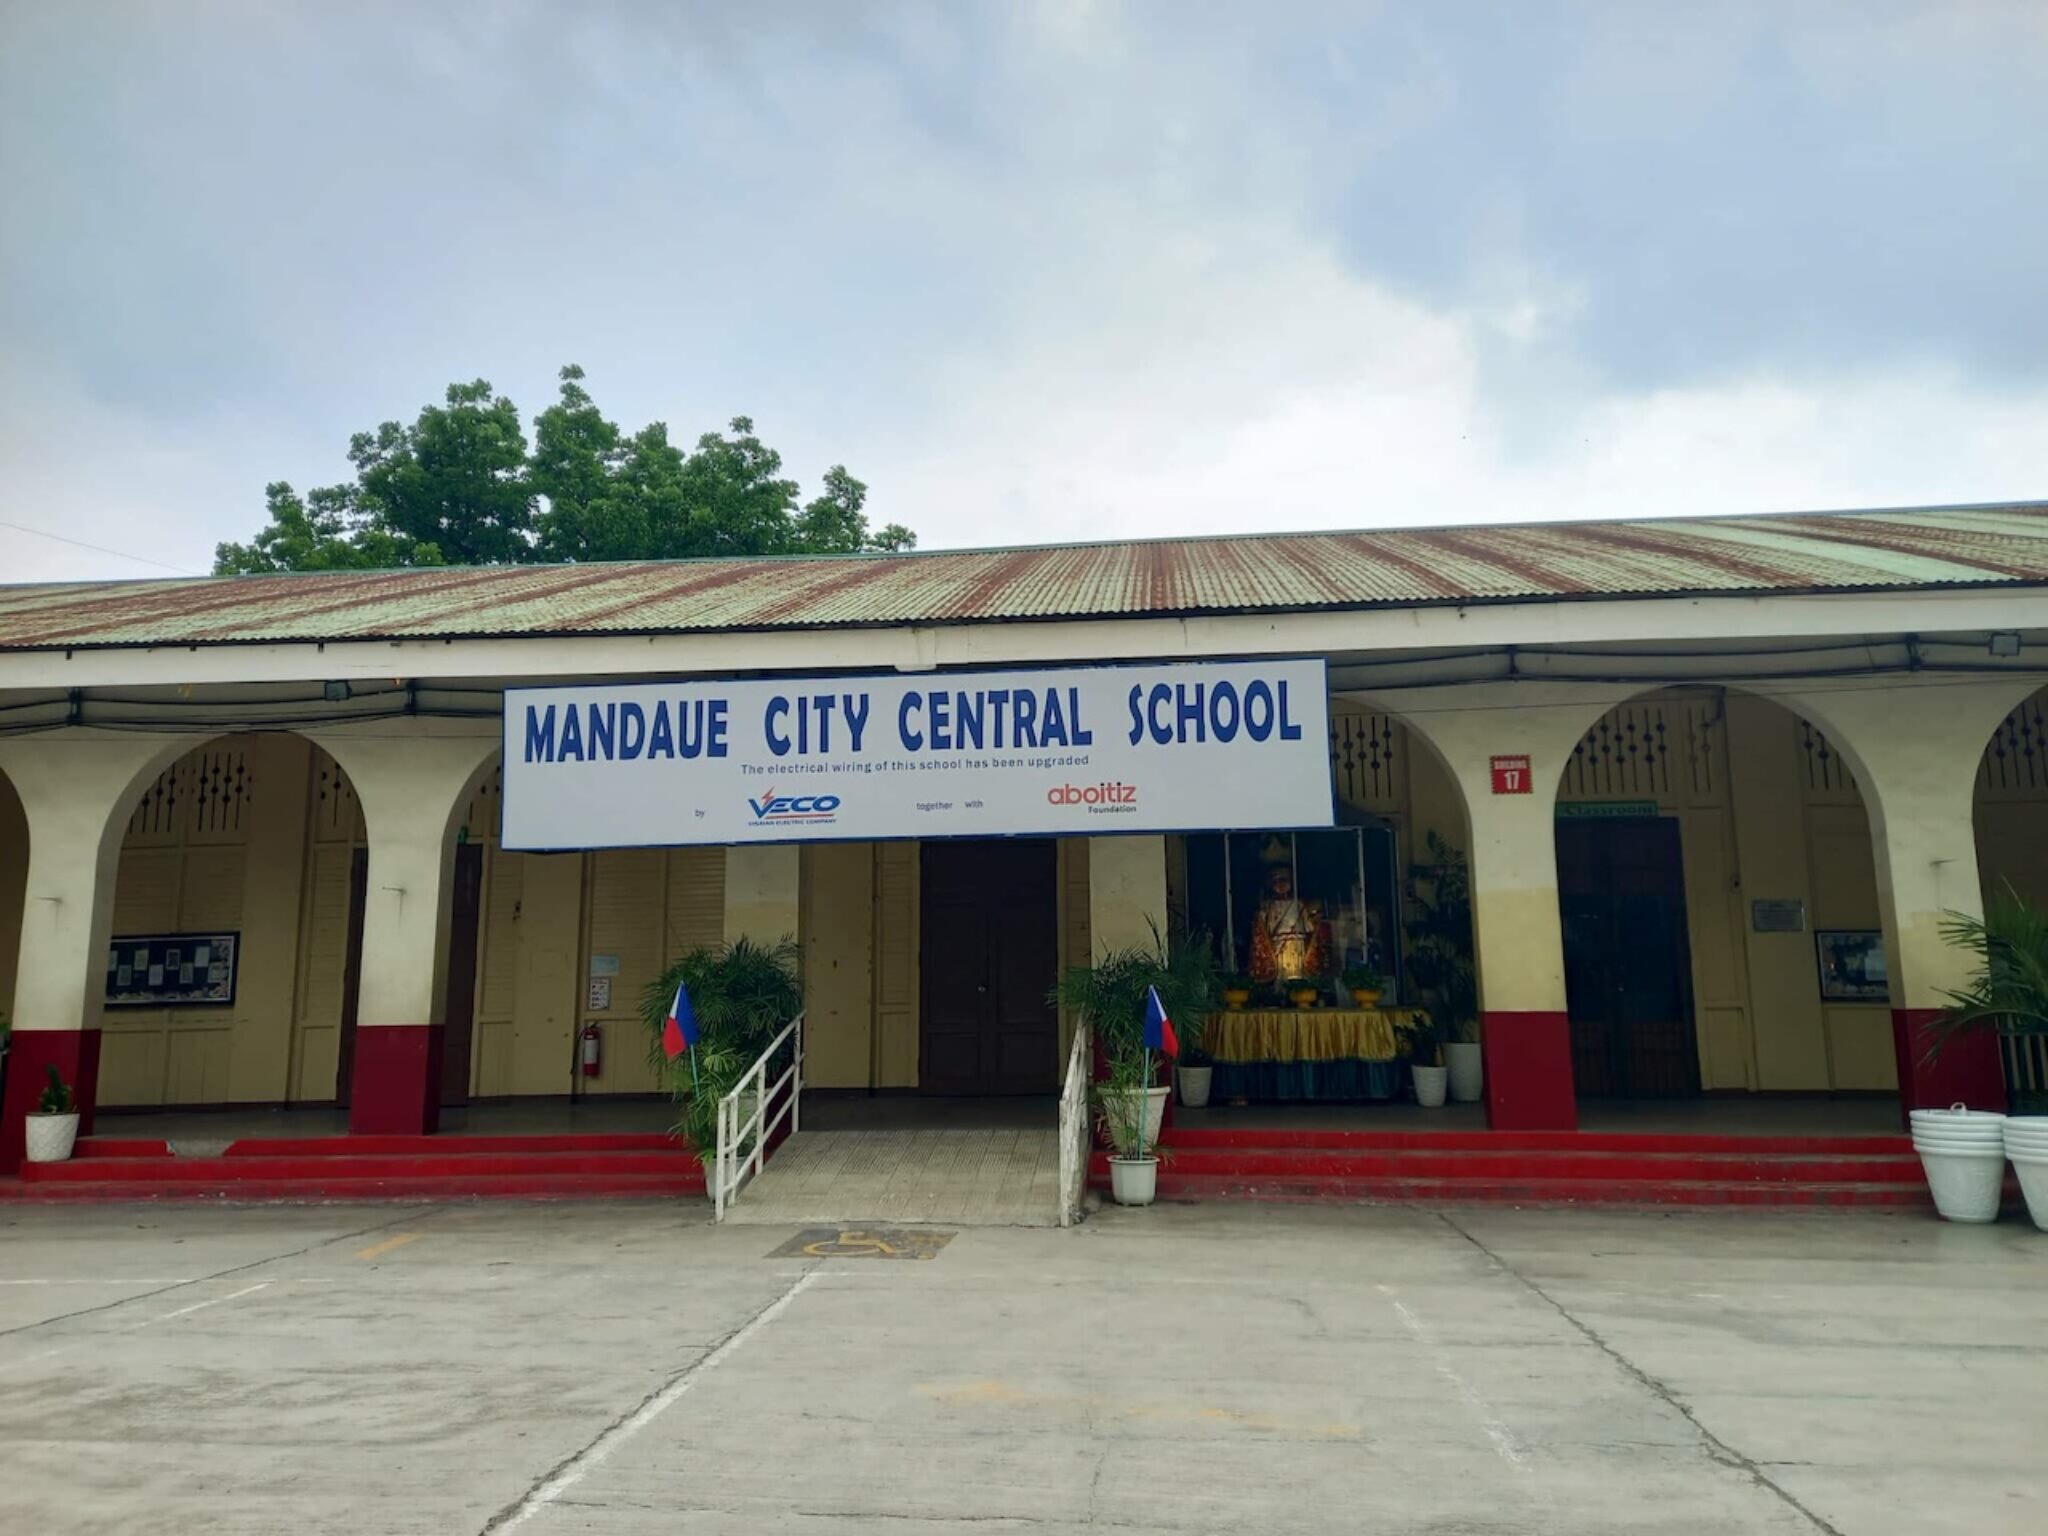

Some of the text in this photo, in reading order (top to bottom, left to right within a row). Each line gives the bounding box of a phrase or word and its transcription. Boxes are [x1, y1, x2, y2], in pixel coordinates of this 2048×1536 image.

[524, 679, 1301, 763] MANDAUE CITY CENTRAL SCHOOL
[741, 755, 1089, 774] The electrical wiring of this school has been upgraded
[1504, 771, 1520, 790] 17
[1048, 782, 1136, 805] aboitiz
[695, 809, 705, 819] by
[747, 795, 840, 818] VECO
[916, 800, 983, 812] together with
[1088, 805, 1137, 814] Foundation
